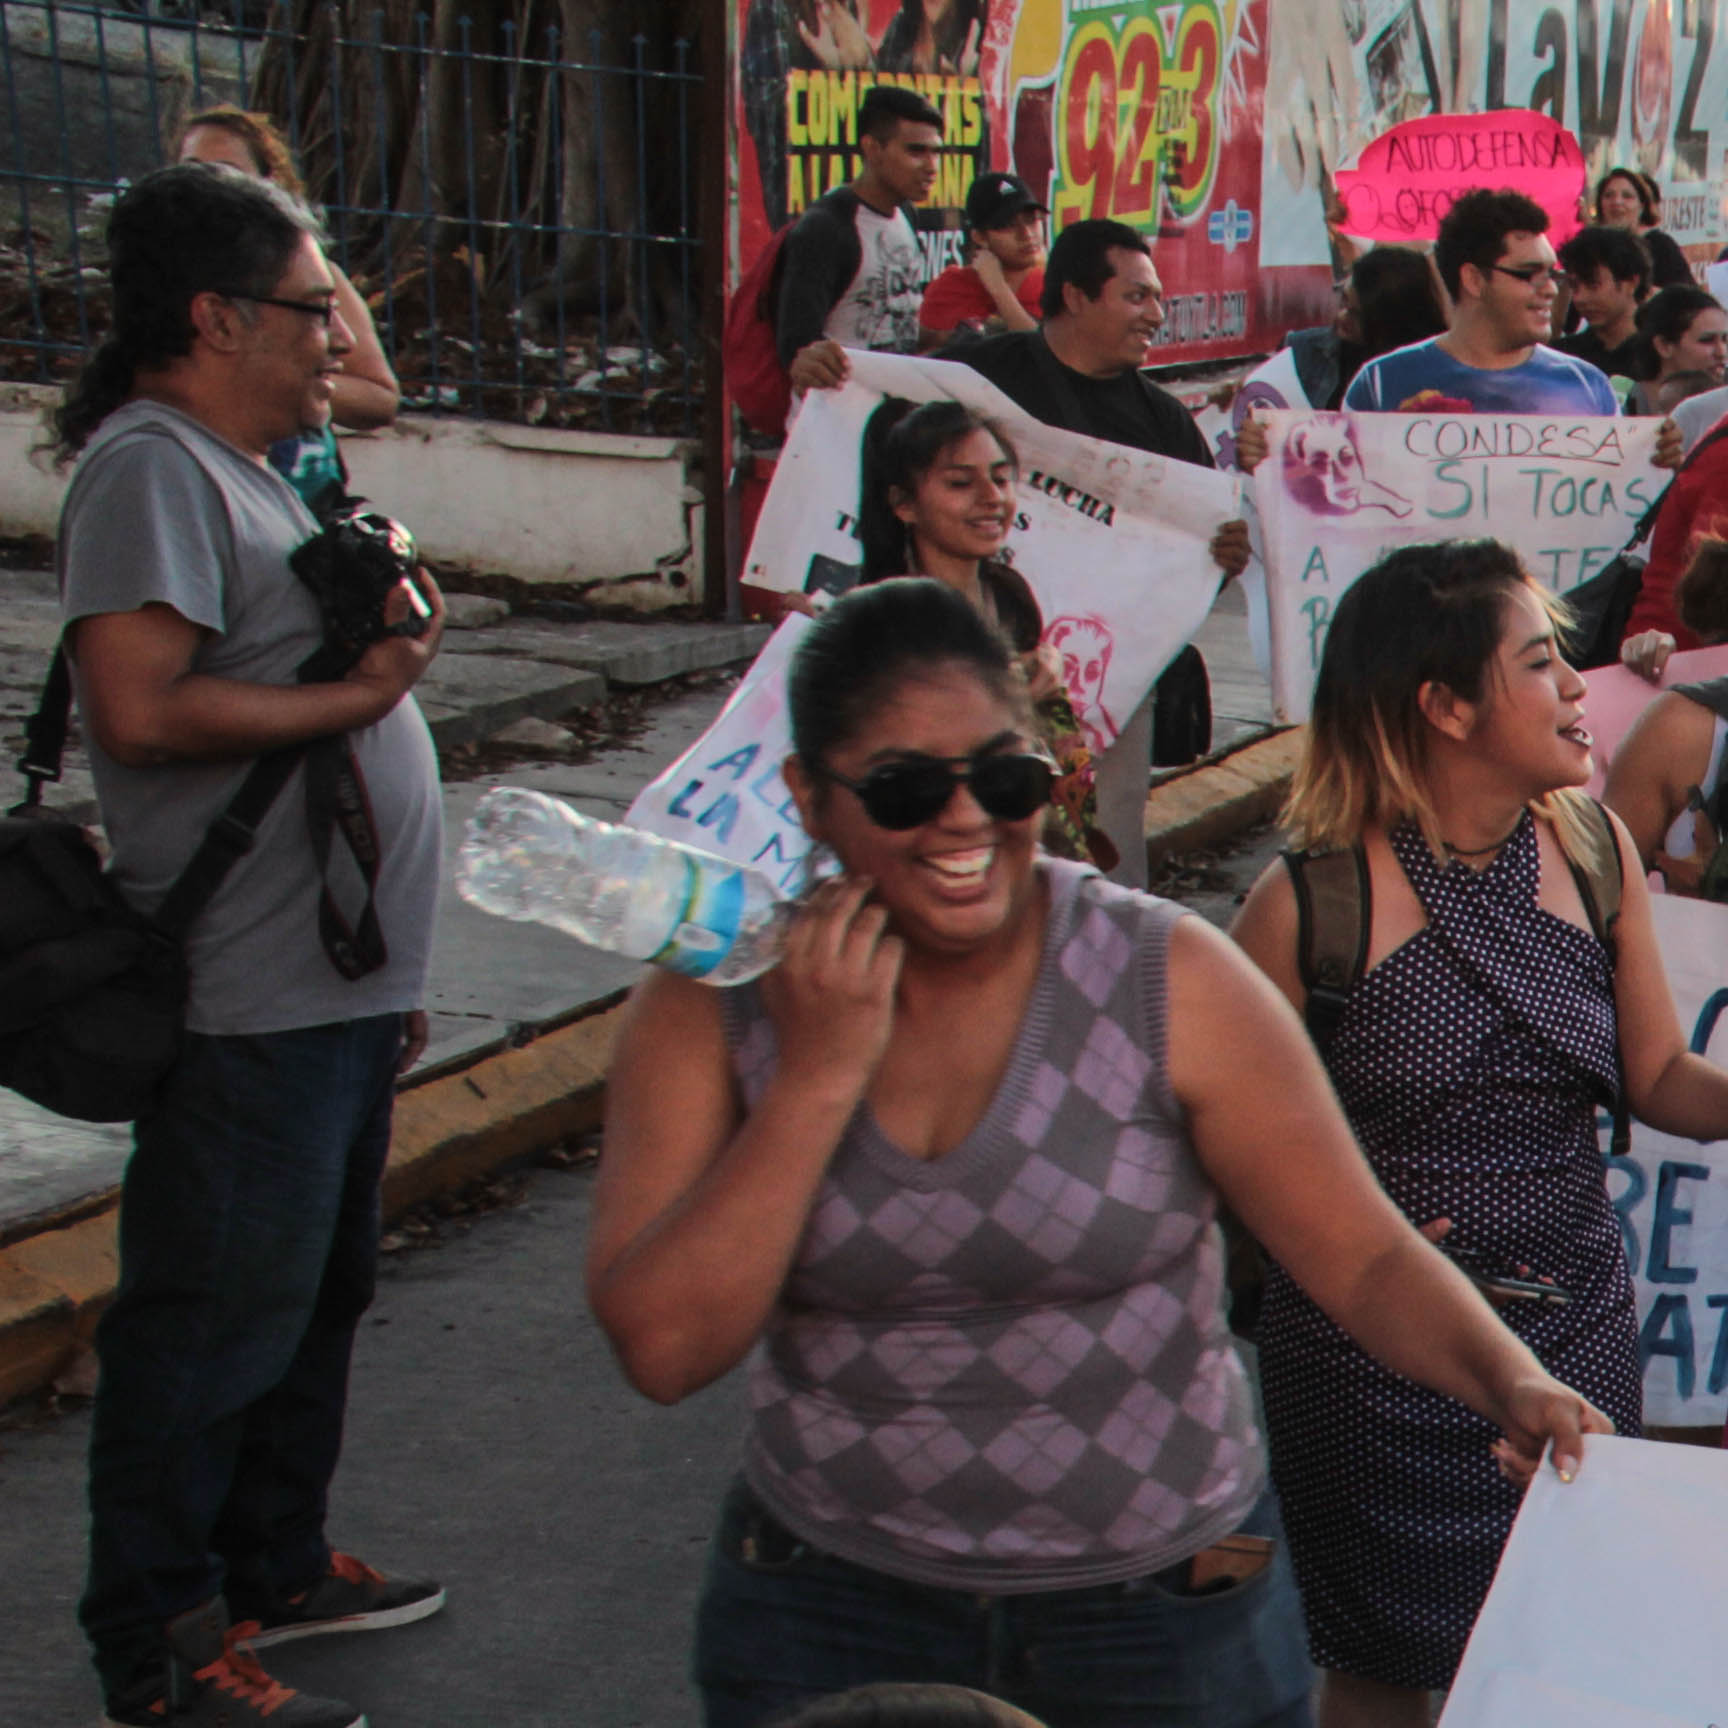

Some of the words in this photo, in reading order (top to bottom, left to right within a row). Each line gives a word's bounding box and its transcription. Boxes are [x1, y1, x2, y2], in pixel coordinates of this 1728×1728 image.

[1386, 130, 1571, 174] AUTODEFENSA
[1028, 470, 1118, 528] LUCHA
[1426, 459, 1491, 520] SI
[1519, 468, 1655, 520] TOCAS
